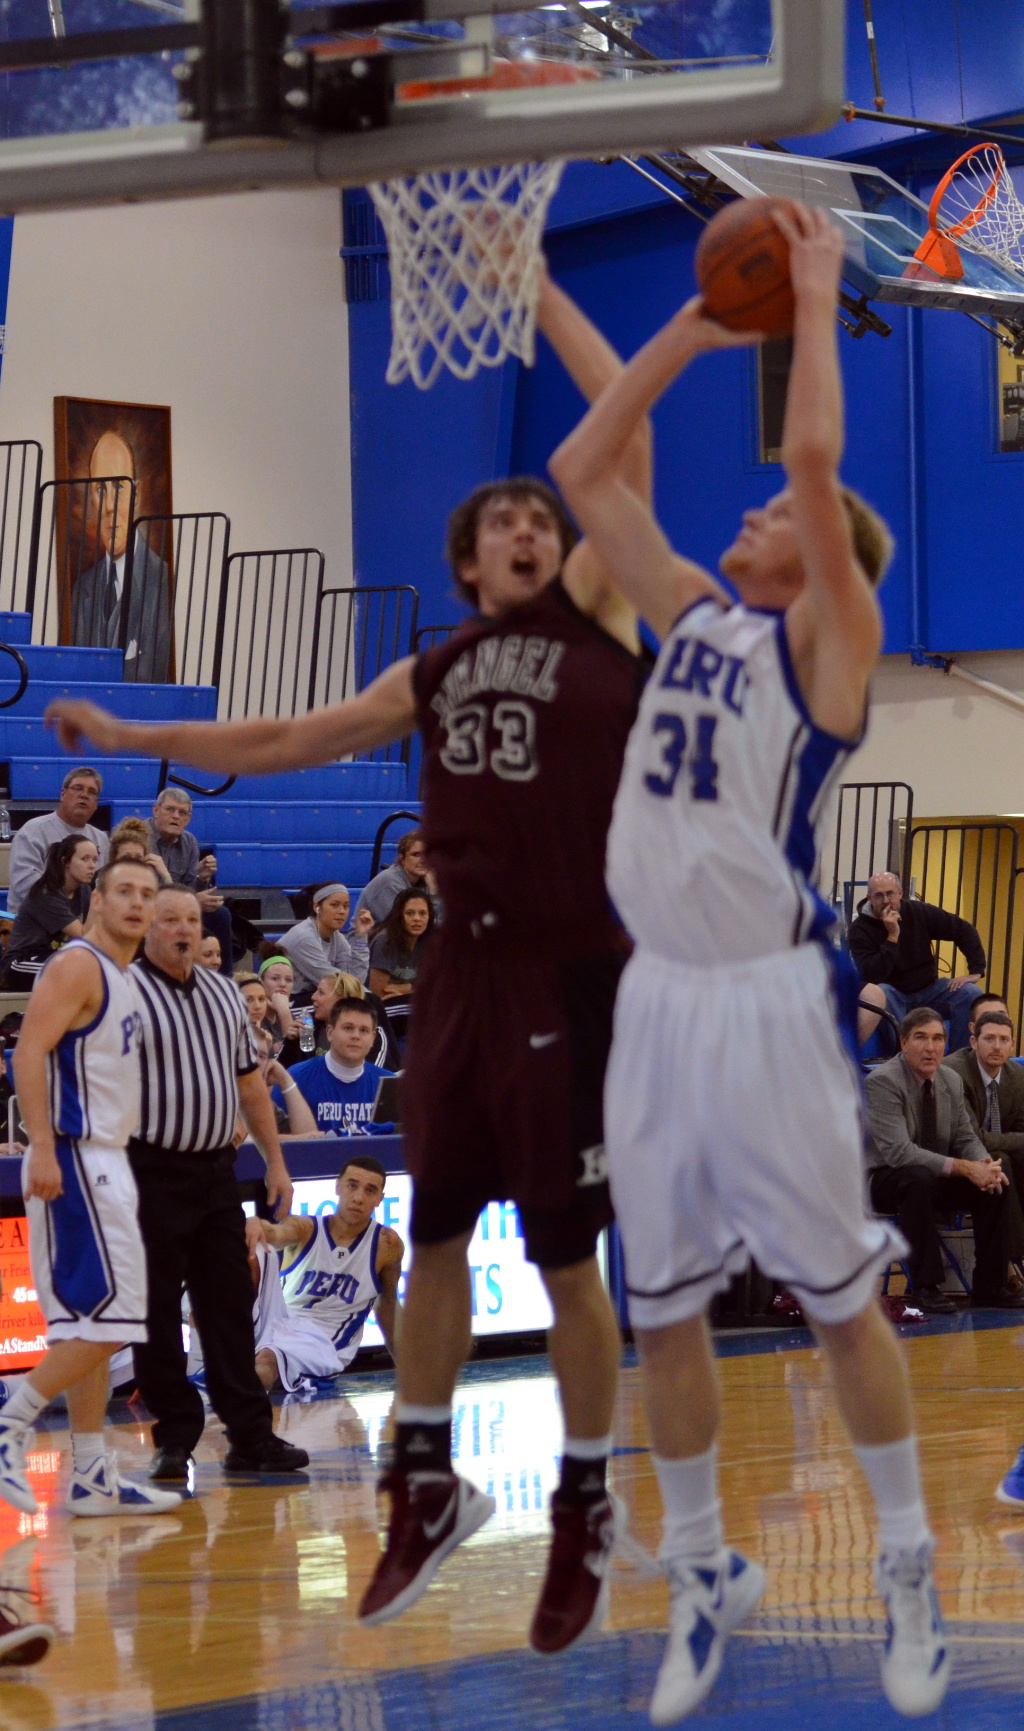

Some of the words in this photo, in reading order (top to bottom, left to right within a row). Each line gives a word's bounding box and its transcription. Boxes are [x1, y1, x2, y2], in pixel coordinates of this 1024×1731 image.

[439, 700, 541, 782] 33
[317, 1102, 343, 1121] PERU
[337, 1251, 345, 1259] P
